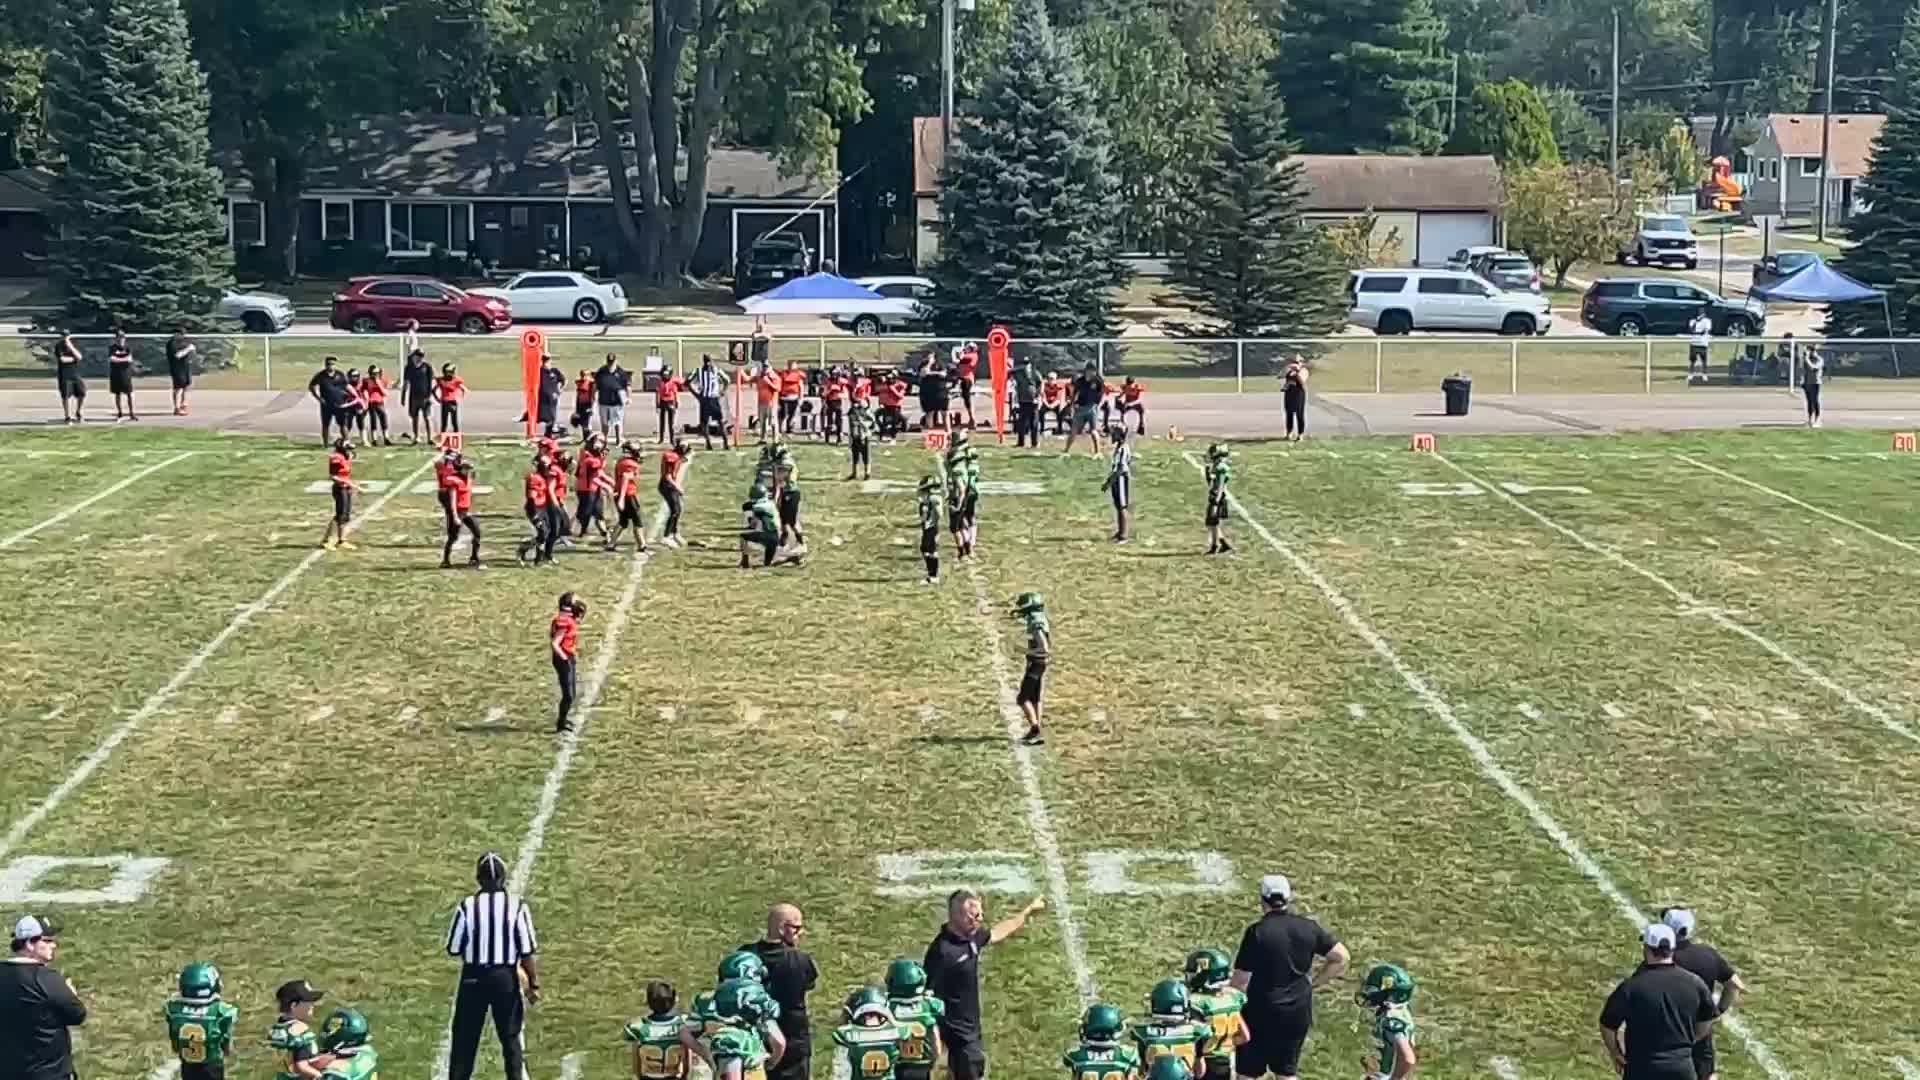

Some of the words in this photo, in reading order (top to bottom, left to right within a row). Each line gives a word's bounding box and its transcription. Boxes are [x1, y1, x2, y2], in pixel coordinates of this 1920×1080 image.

[442, 435, 459, 449] 40
[927, 433, 945, 449] 50
[1416, 437, 1432, 451] 40
[1896, 436, 1913, 450] 30
[179, 1023, 206, 1063] 3
